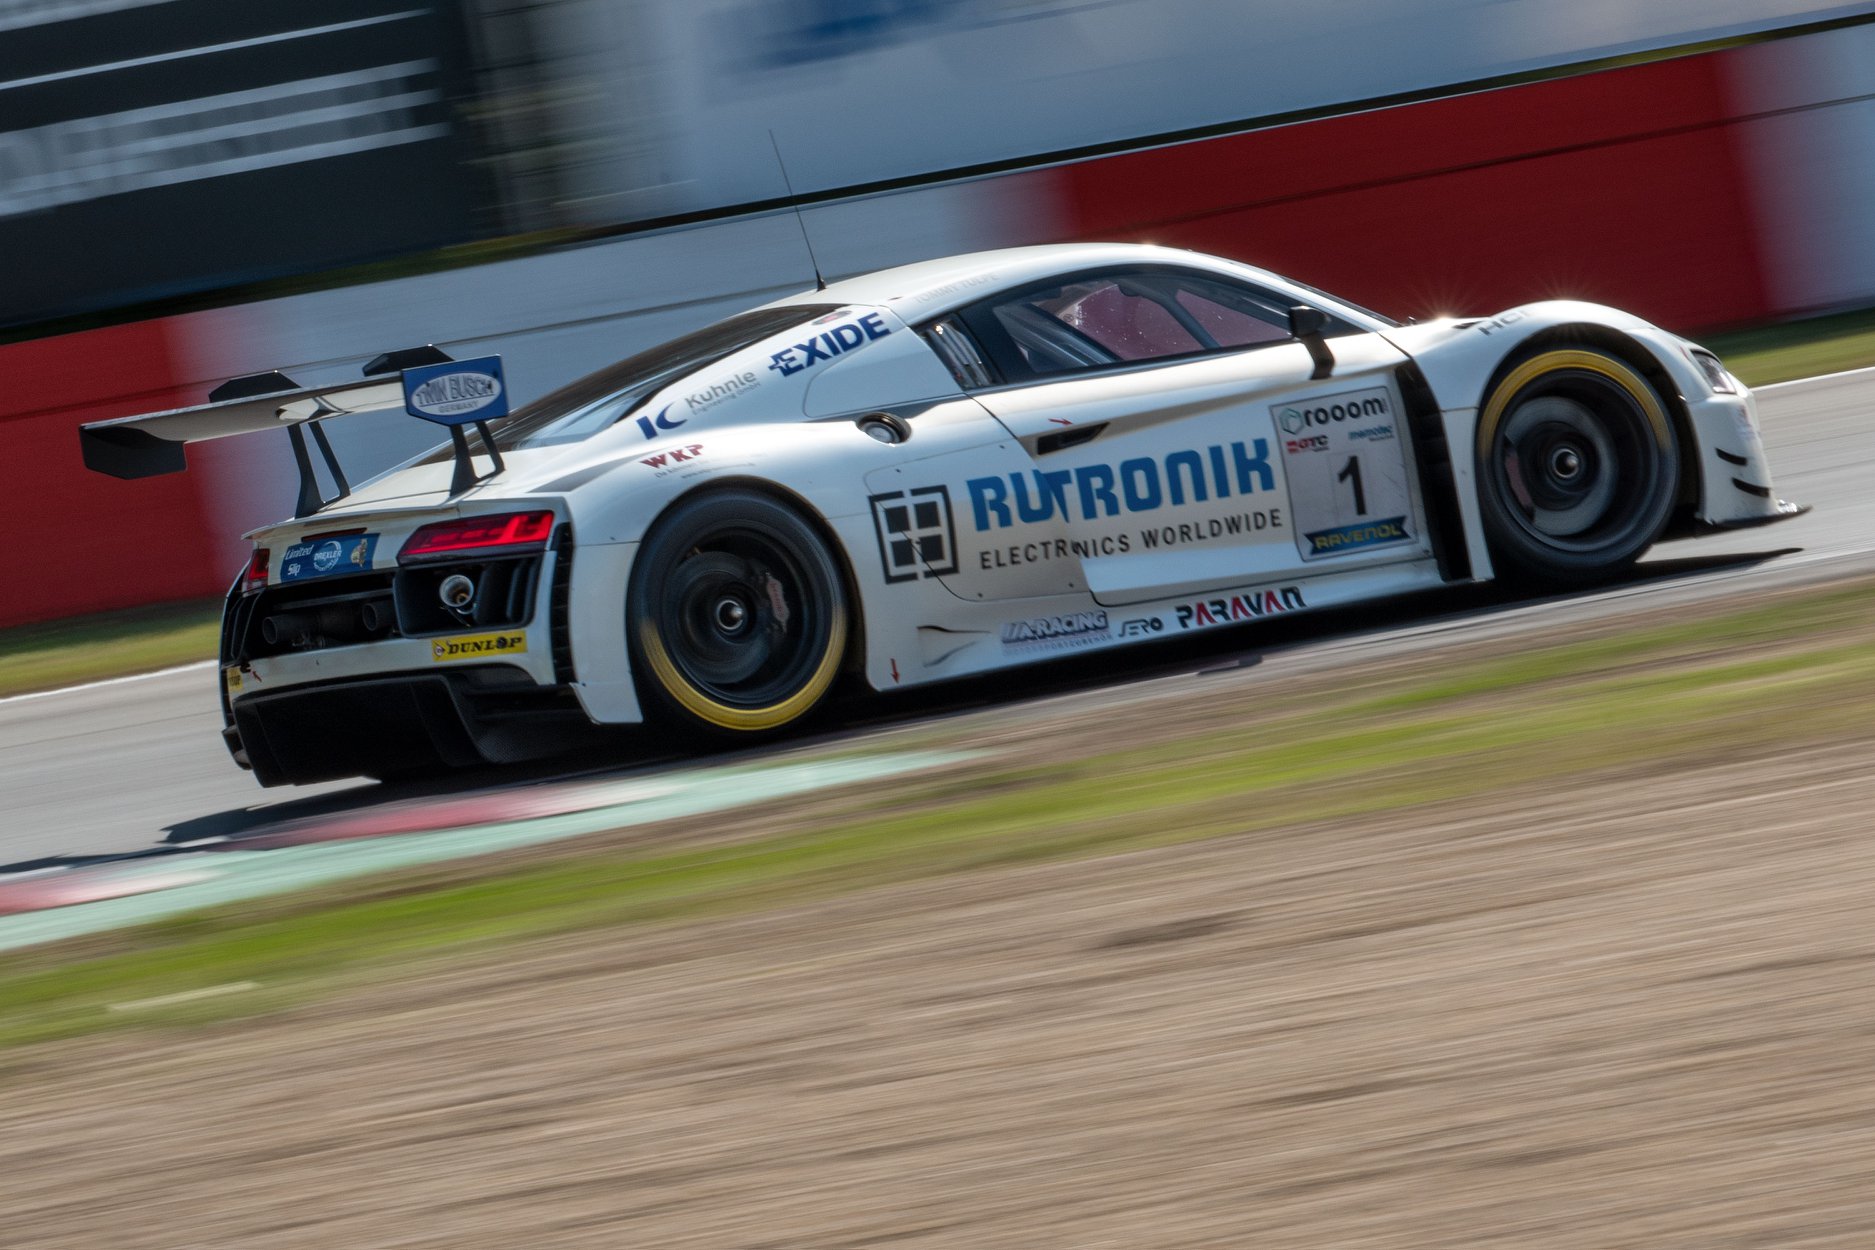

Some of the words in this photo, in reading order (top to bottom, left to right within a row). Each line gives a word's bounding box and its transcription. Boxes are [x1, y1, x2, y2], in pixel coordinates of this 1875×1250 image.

[768, 312, 892, 377] EXIDE
[451, 375, 493, 400] BUSCH
[685, 372, 756, 408] Kuhnle
[1304, 397, 1385, 428] rooom
[640, 443, 704, 469] WKP
[966, 438, 1277, 532] RUTRONIK
[1338, 455, 1367, 515] 1
[1141, 508, 1283, 549] WORLDWIDE
[1314, 523, 1402, 551] RAVENOL
[1175, 585, 1308, 630] PARAVAN
[447, 635, 523, 655] DUNLOP
